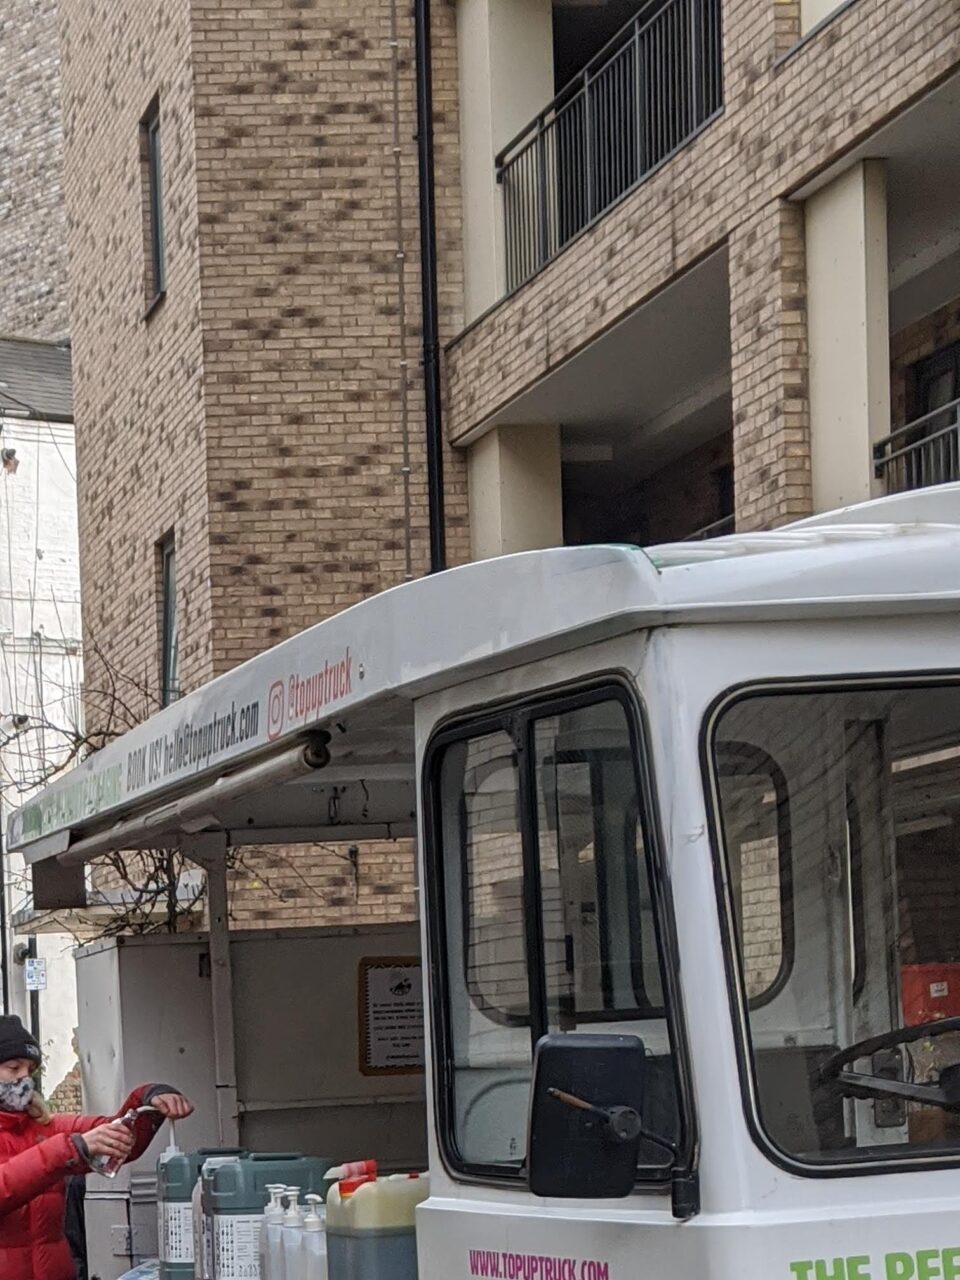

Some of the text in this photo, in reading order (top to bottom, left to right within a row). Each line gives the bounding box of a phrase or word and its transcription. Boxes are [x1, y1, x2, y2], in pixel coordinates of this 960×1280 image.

[288, 646, 352, 724] @topuptruck
[126, 744, 147, 793] BOOK
[163, 700, 259, 772] hello@topuptruck.com
